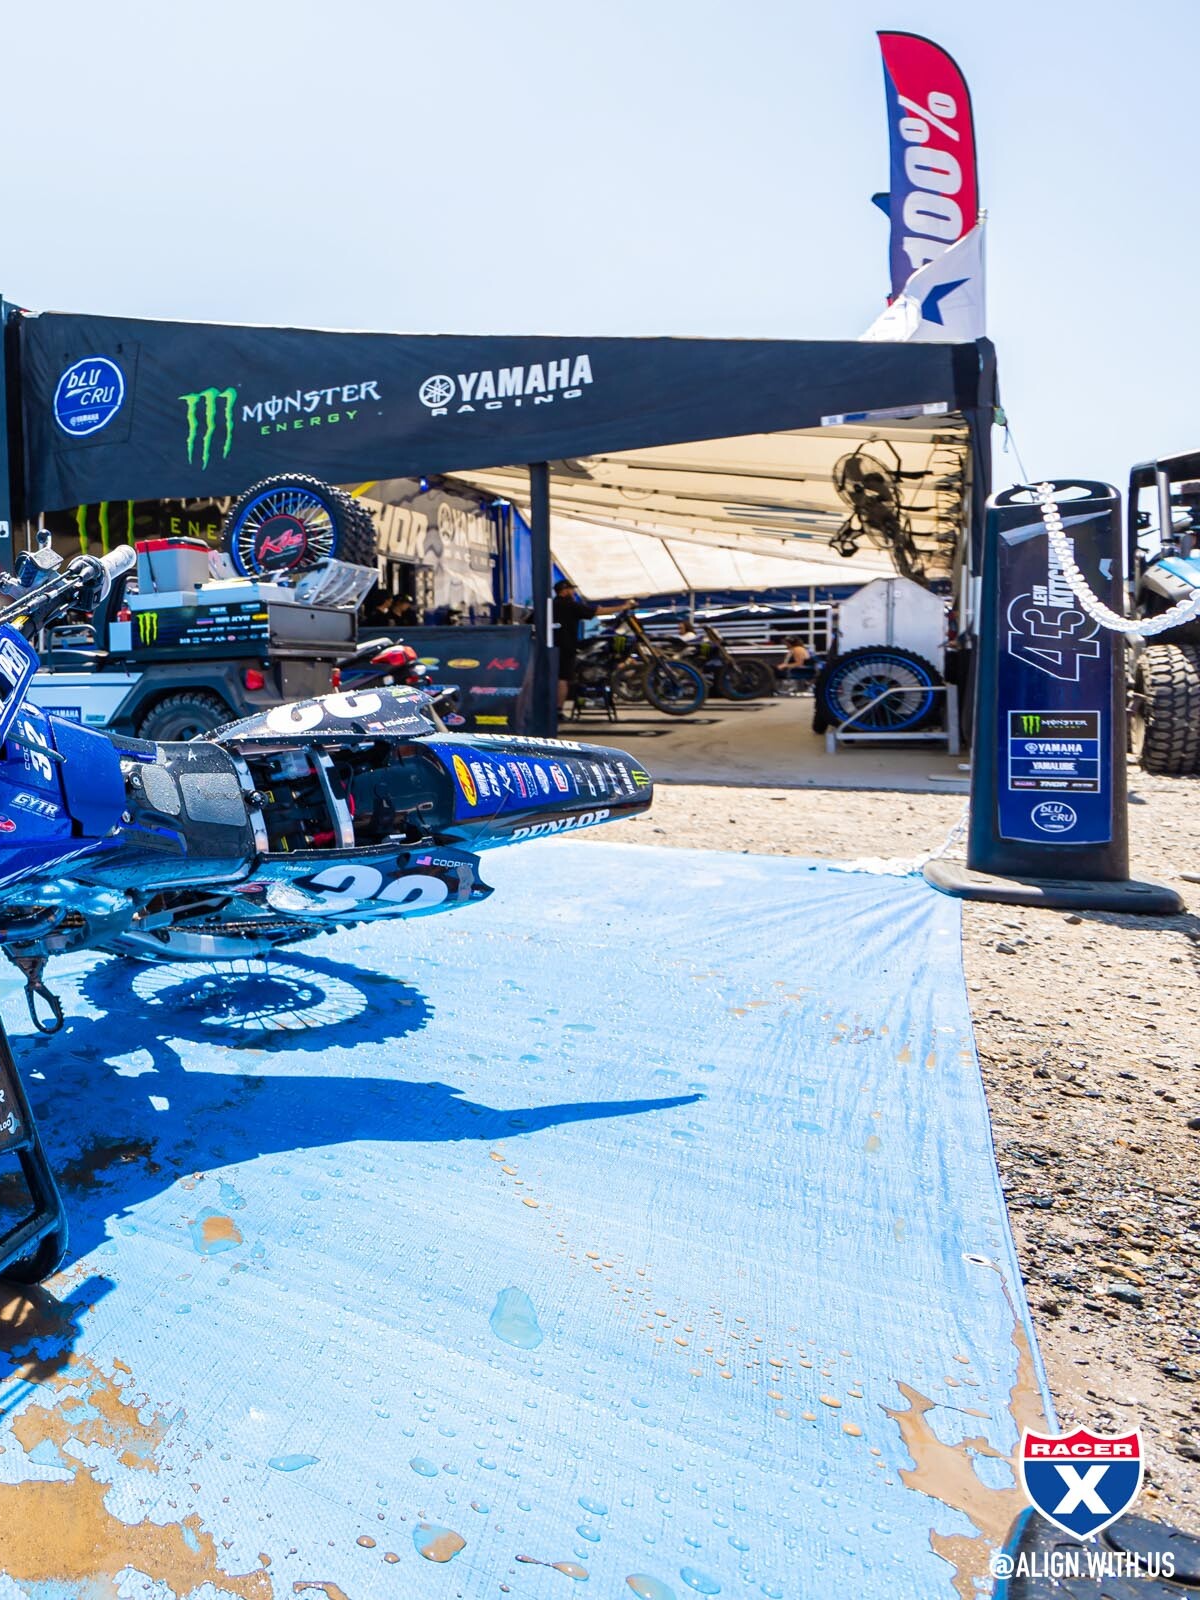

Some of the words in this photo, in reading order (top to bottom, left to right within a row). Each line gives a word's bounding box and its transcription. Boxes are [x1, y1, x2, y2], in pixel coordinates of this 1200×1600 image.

[457, 354, 594, 401] YAMAHA
[242, 380, 382, 424] MONSTER
[431, 390, 583, 417] RACING
[261, 409, 360, 436] ENERGY
[170, 518, 218, 540] ENE
[1033, 585, 1048, 606] LEVI
[1038, 743, 1083, 753] YAMAHA
[12, 792, 60, 817] GYTR
[508, 809, 610, 842] DUNLOP
